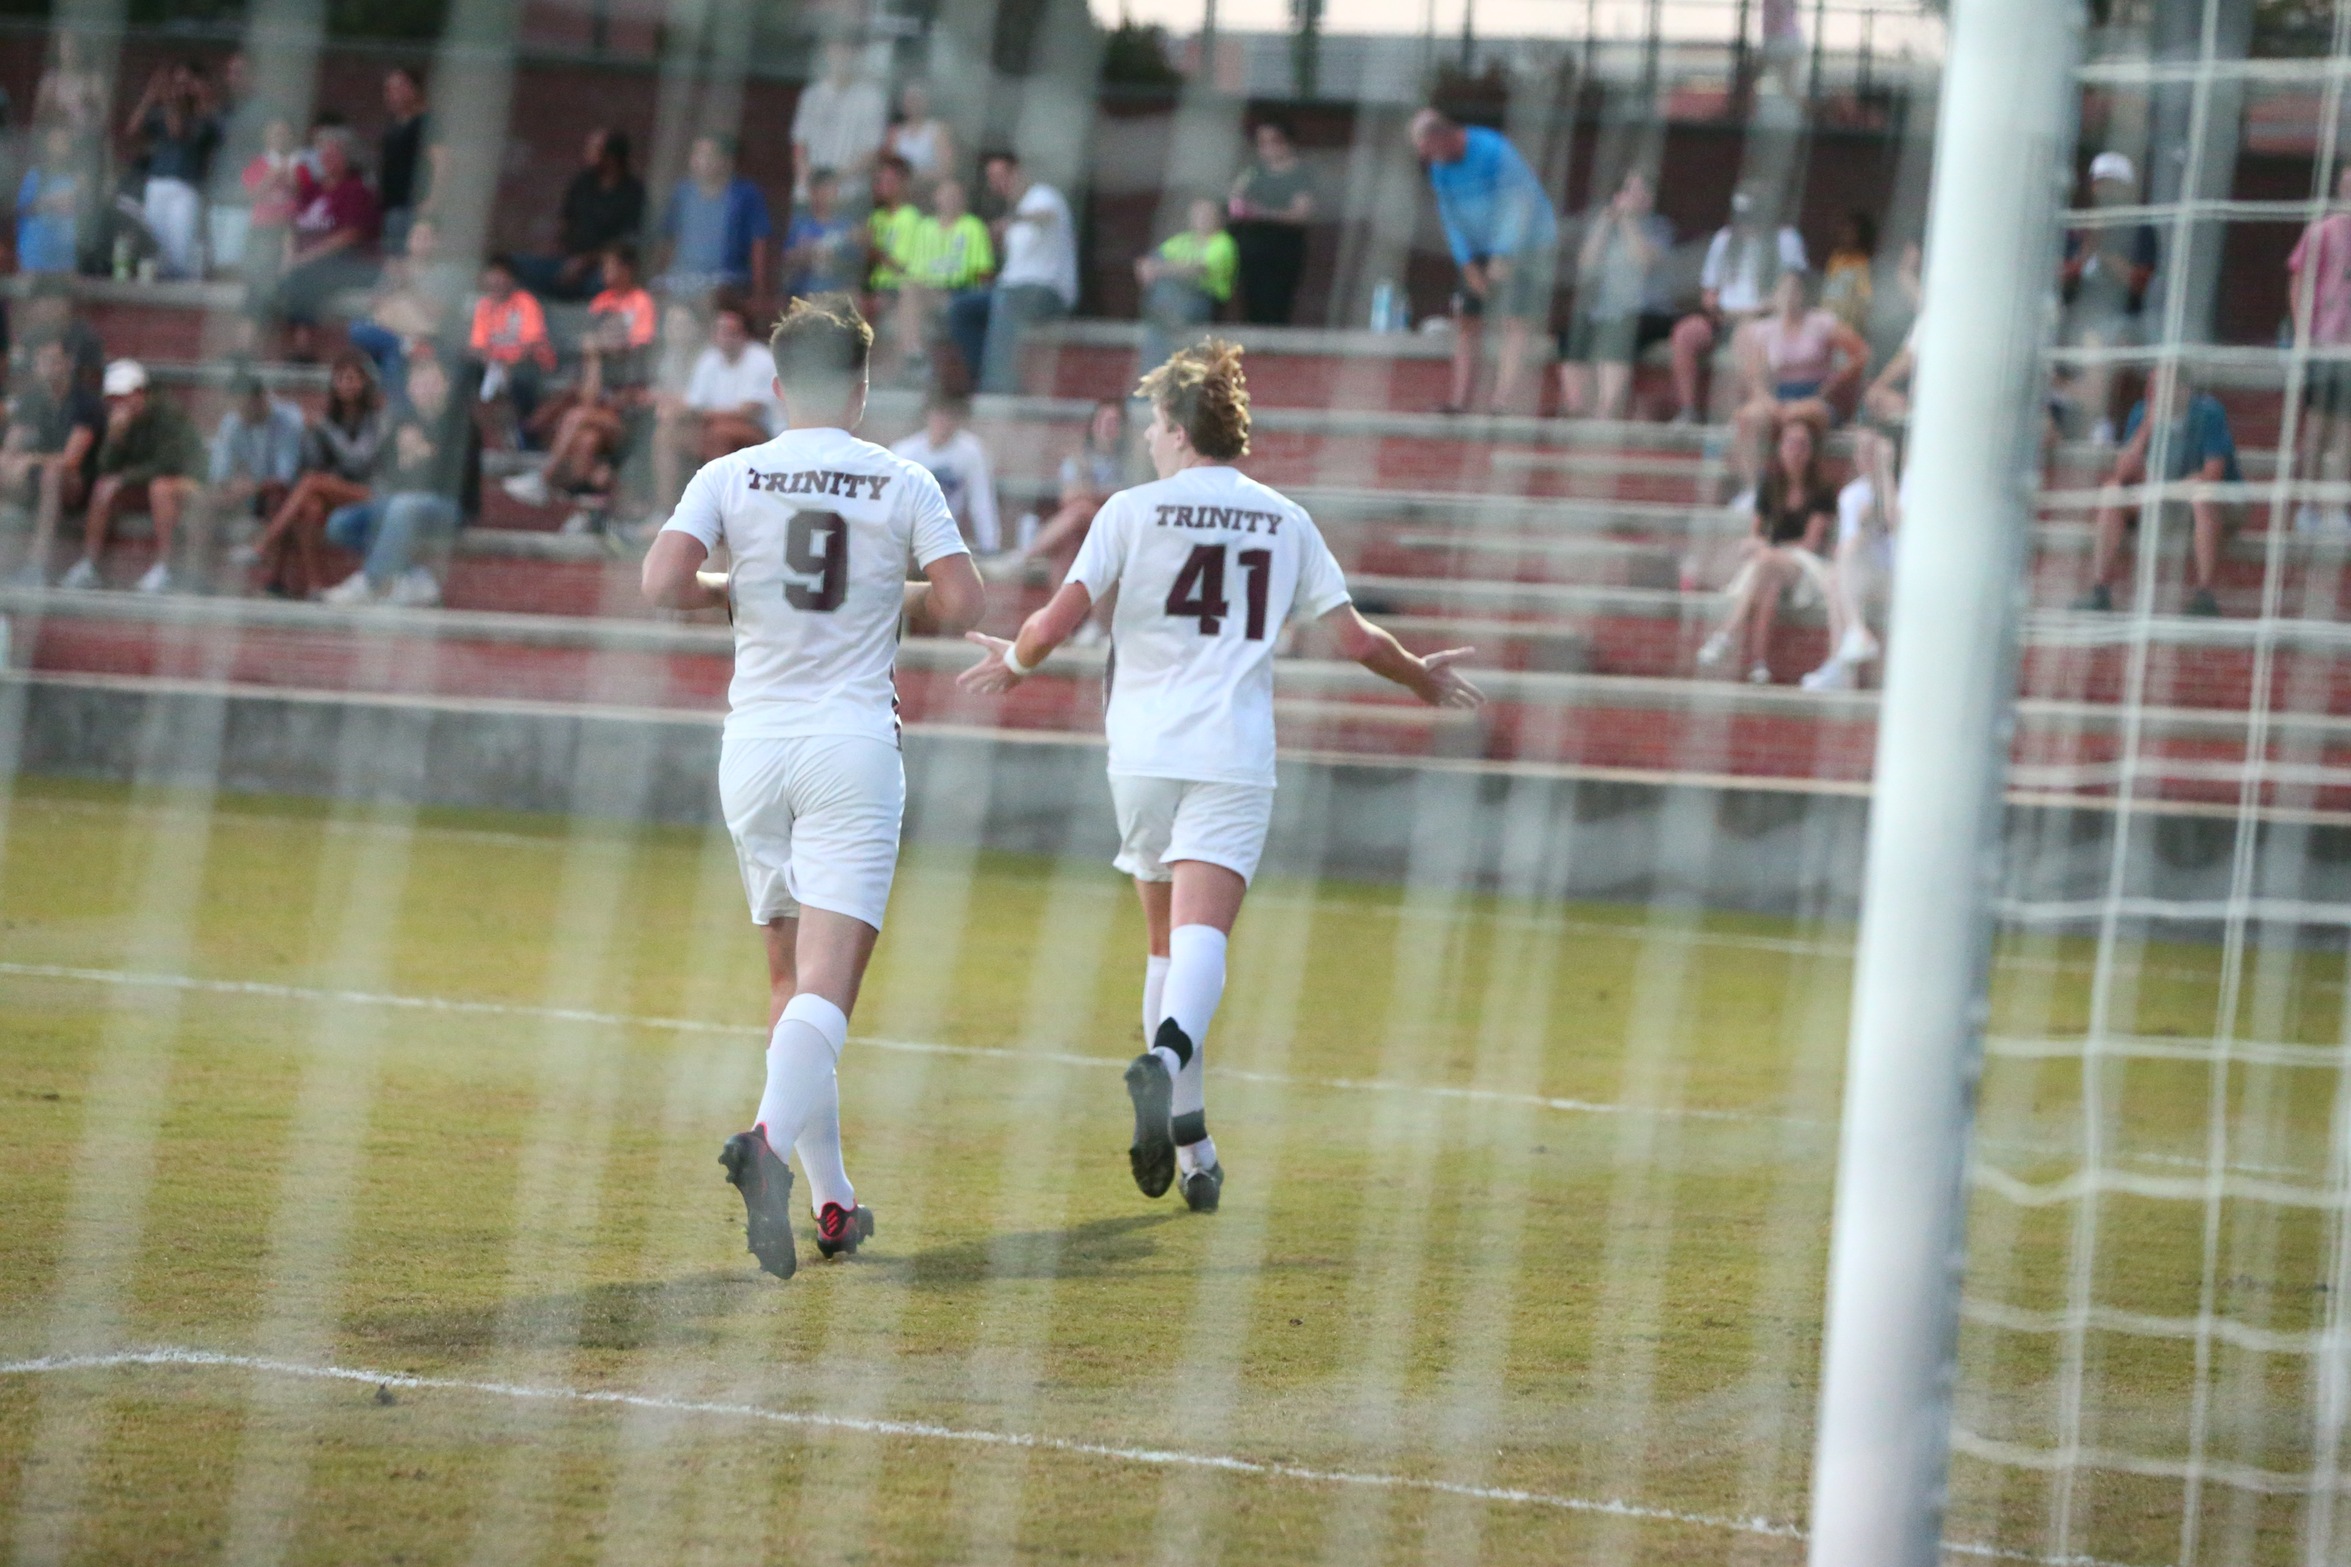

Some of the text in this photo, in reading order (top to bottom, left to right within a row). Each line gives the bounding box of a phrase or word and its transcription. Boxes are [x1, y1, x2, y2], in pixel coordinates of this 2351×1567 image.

[748, 467, 891, 500] TRINITY
[1156, 505, 1283, 535] TRINITY
[784, 509, 848, 612] 9
[1165, 543, 1272, 640] 41
